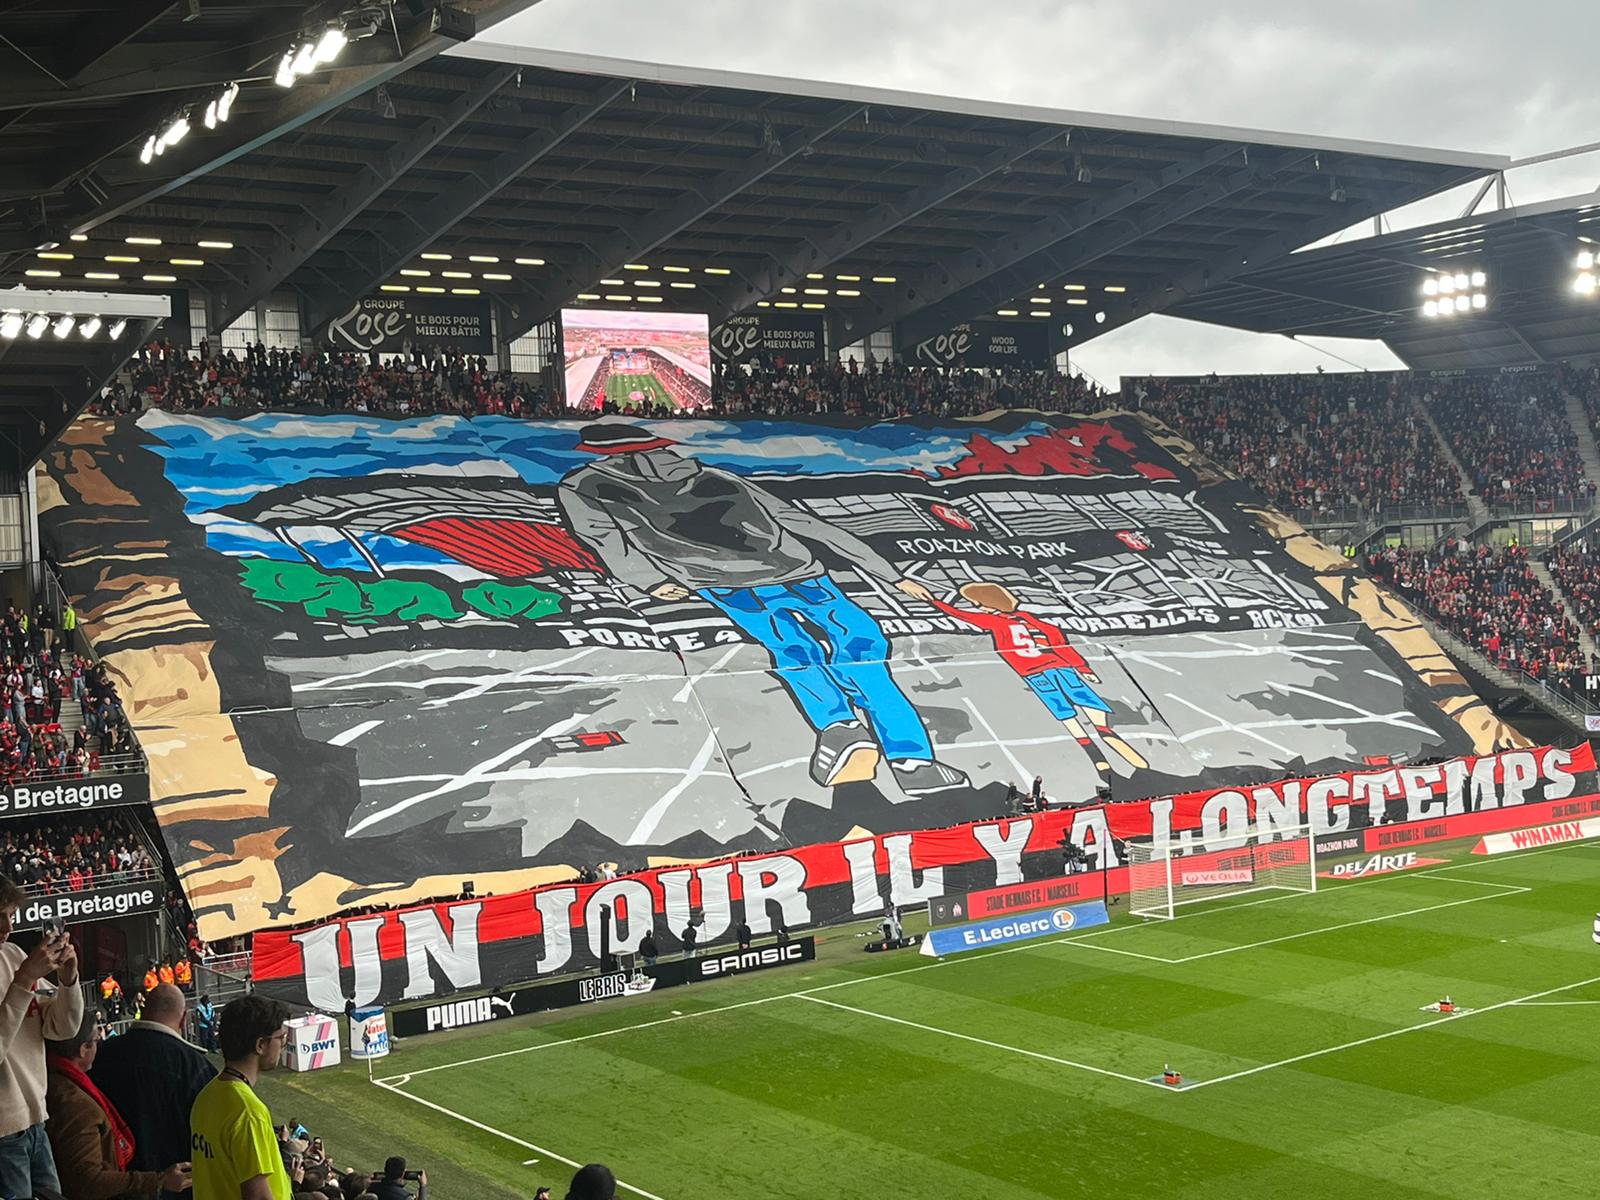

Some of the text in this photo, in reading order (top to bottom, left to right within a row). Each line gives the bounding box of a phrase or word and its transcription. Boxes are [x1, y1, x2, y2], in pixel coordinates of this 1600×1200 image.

[364, 300, 405, 309] GROUPE
[415, 316, 480, 326] LE BOIS POUR
[416, 324, 481, 337] MIEUX BÂTIR
[763, 330, 815, 339] LE BOIS POUR
[764, 339, 815, 349] MIEUX BÂTIR
[992, 336, 1015, 345] WOOD
[896, 539, 1076, 559] ROAZHON PARK
[14, 783, 123, 809] Bretagne
[1510, 822, 1585, 849] WINAMAX
[1343, 839, 1358, 849] PARK
[293, 749, 1576, 1014] UN JOUR IL Y A LONGTEMPS
[1200, 872, 1248, 882] VEOLIA
[26, 903, 52, 920] de
[57, 890, 154, 917] Bretagne
[701, 945, 803, 975] SAMSIC
[427, 998, 491, 1031] PUMA
[311, 1039, 336, 1052] BWT
